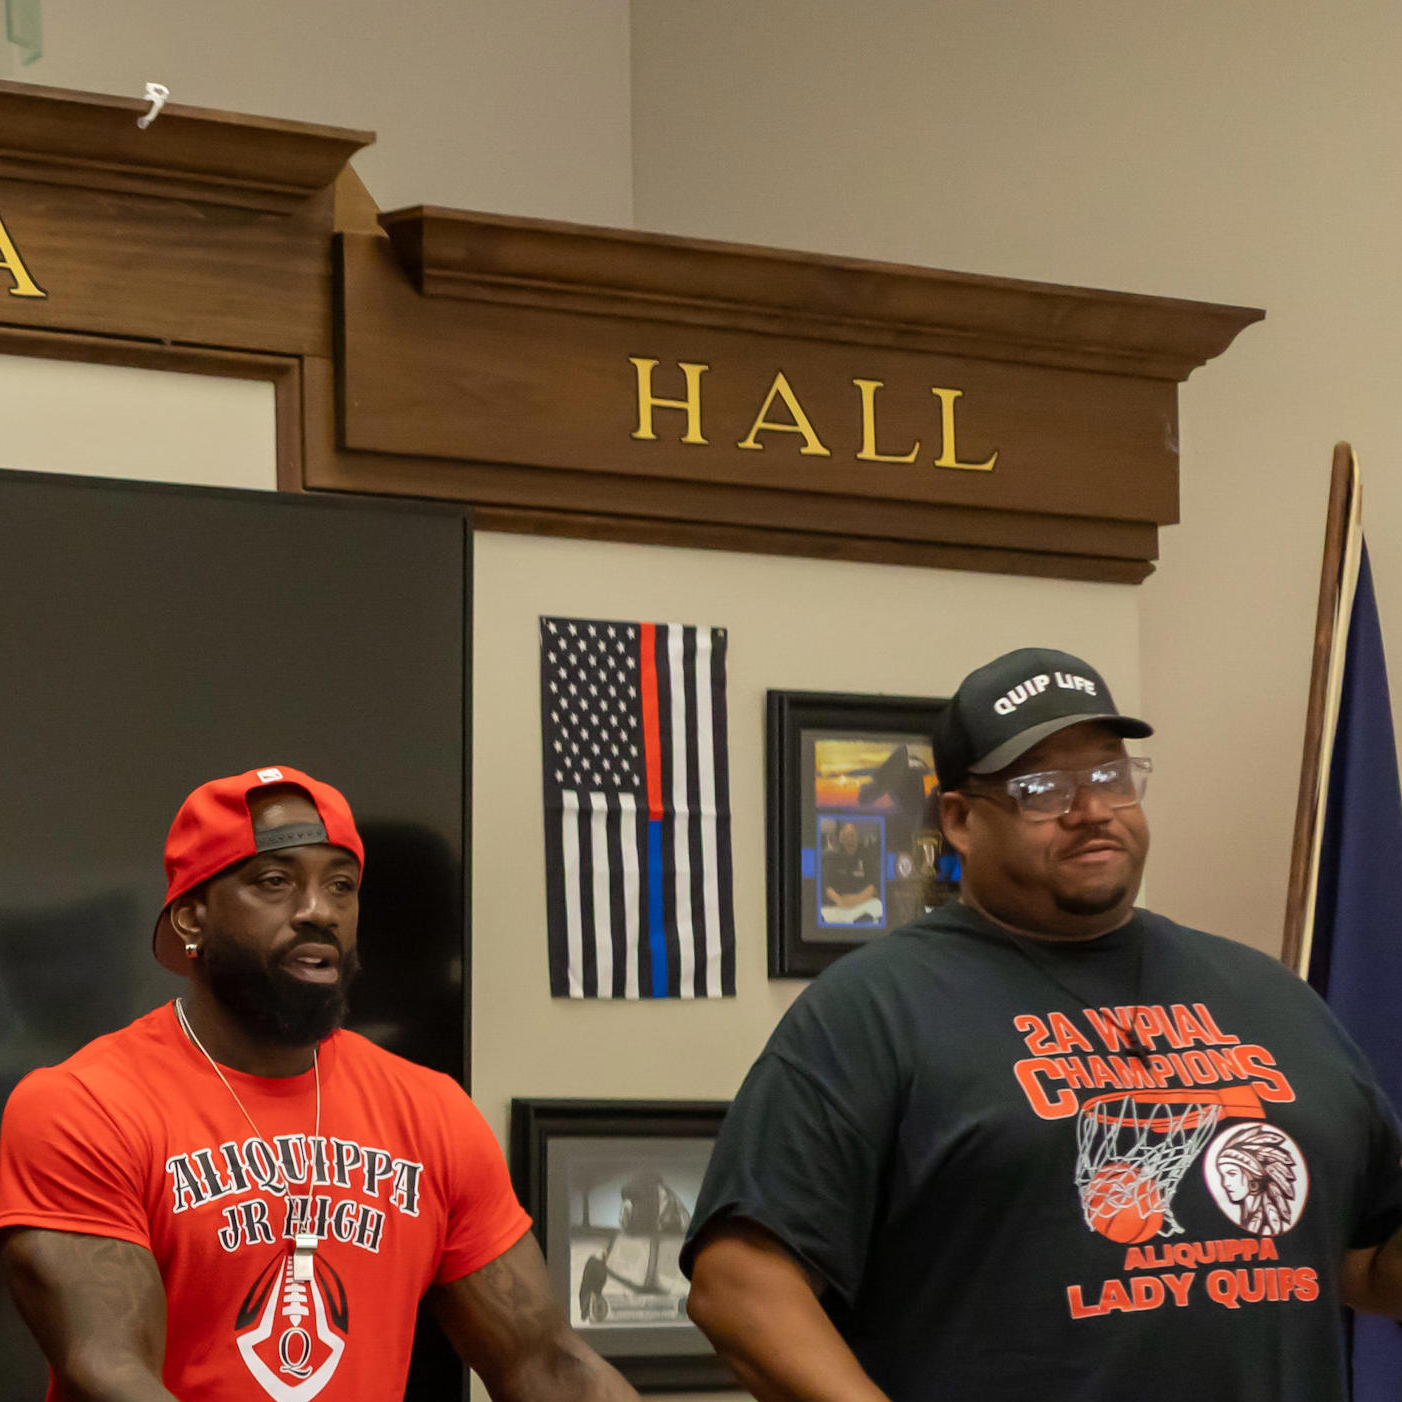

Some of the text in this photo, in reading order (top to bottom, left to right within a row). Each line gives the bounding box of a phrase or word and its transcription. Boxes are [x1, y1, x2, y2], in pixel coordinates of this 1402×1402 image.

[628, 357, 998, 471] HALL
[994, 671, 1097, 715] QUIP LIFE
[1013, 1003, 1241, 1056] 2A WPIAL
[1013, 1044, 1296, 1120] CHAMPIONS
[166, 1134, 423, 1216] ALIQUIPPA
[218, 1195, 386, 1253] JR HIGH
[1124, 1238, 1279, 1271] ALIQUIPPA
[1066, 1267, 1319, 1320] LADY QUIPS
[279, 1327, 313, 1378] Q
